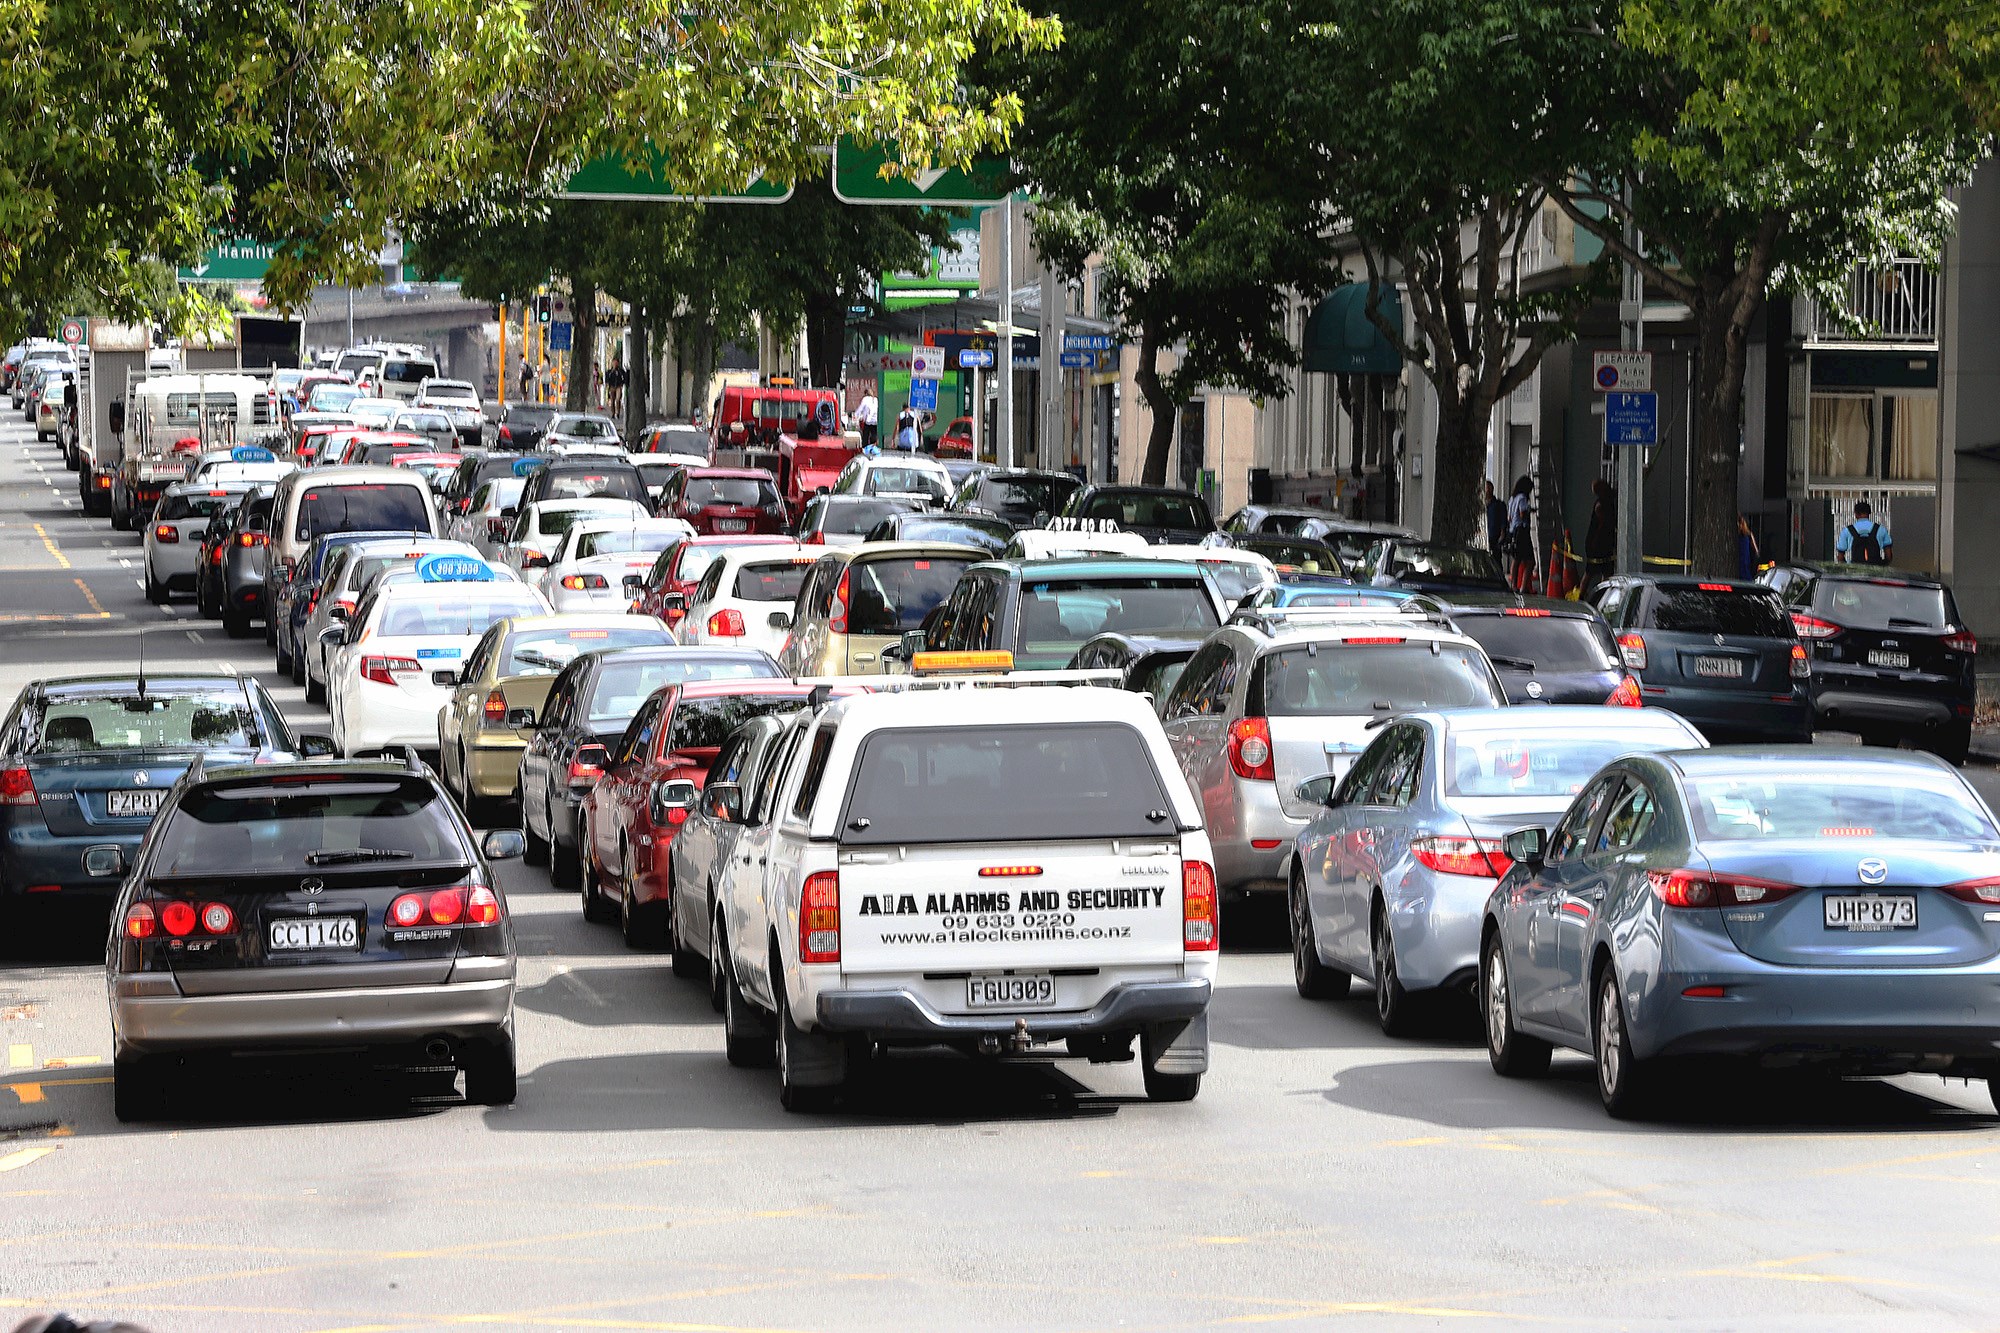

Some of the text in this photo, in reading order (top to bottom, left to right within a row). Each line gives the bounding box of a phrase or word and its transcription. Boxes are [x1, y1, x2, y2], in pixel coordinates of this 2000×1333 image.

[1066, 335, 1103, 350] NICHOLAS
[1599, 355, 1646, 364] CLEARWAY
[110, 791, 161, 813] FZP81
[925, 891, 1010, 915] ALARMS
[1018, 889, 1060, 913] AND
[1067, 886, 1165, 912] SECURITY
[1828, 900, 1914, 922] JHP873
[942, 913, 1075, 929] 09 633 0220
[271, 920, 355, 947] CCT146
[880, 926, 1131, 945] www.a1alocksmiths.co.nz
[971, 980, 1051, 1002] FGU309
